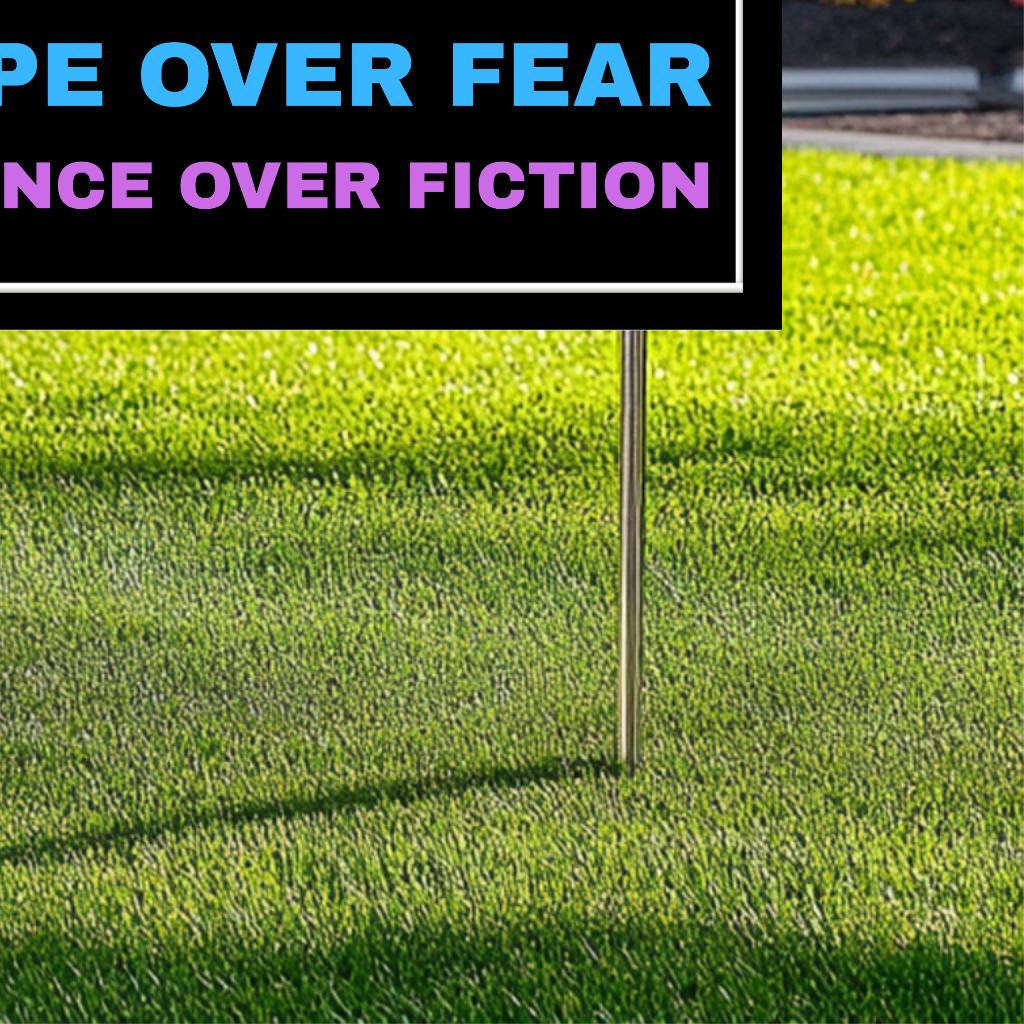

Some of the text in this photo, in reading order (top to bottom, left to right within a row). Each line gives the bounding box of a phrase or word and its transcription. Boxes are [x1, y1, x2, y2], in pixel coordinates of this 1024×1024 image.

[141, 42, 413, 107] OVER
[453, 43, 711, 106] FEAR
[180, 162, 380, 209] OVER
[410, 162, 708, 209] FICTION
